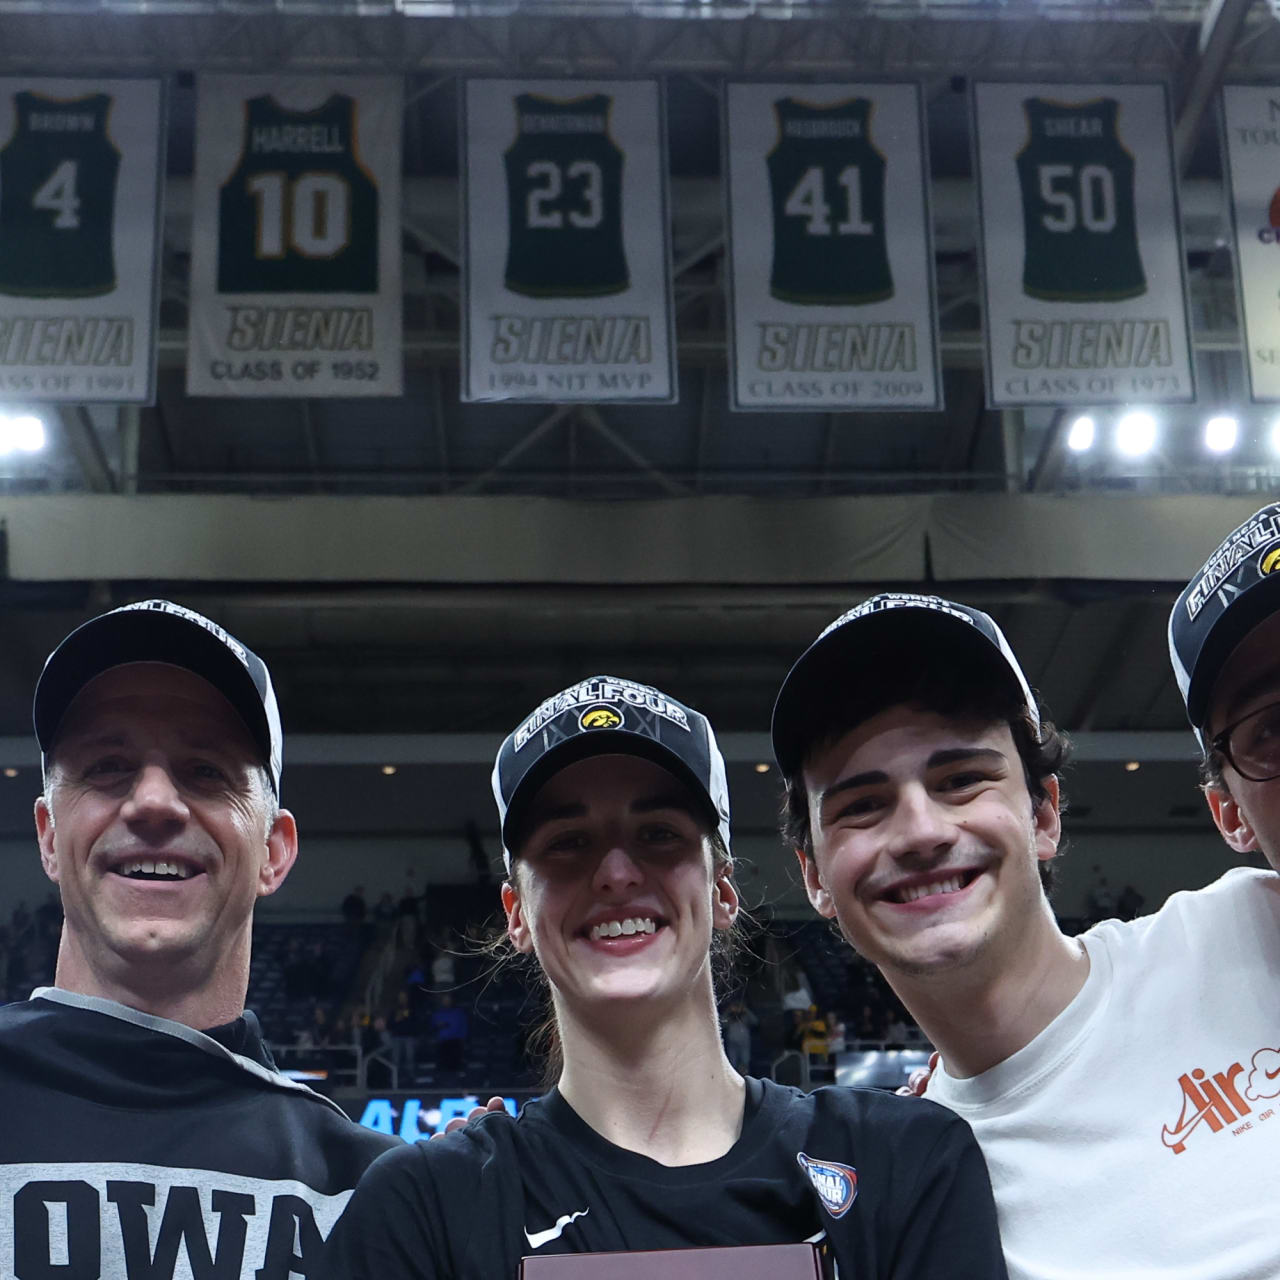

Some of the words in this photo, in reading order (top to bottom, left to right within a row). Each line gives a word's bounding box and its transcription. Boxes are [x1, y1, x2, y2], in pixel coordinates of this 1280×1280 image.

[32, 159, 81, 230] 4
[246, 173, 350, 260] 10
[525, 160, 603, 229] 23
[783, 165, 875, 236] 41
[1038, 164, 1117, 234] 50
[226, 305, 374, 352] SIENA
[488, 313, 652, 365] SIENA
[756, 321, 918, 373] SIENA
[1012, 318, 1173, 370] SIENA
[210, 361, 283, 382] CLASS
[291, 361, 320, 382] OF
[546, 372, 590, 391] NIT
[598, 372, 652, 391] MVP
[748, 381, 825, 400] CLASS
[1004, 378, 1081, 397] CLASS
[1186, 522, 1274, 621] FINAL
[514, 681, 600, 752] FINAL
[599, 682, 692, 732] FOUR
[1161, 1061, 1253, 1155] Air
